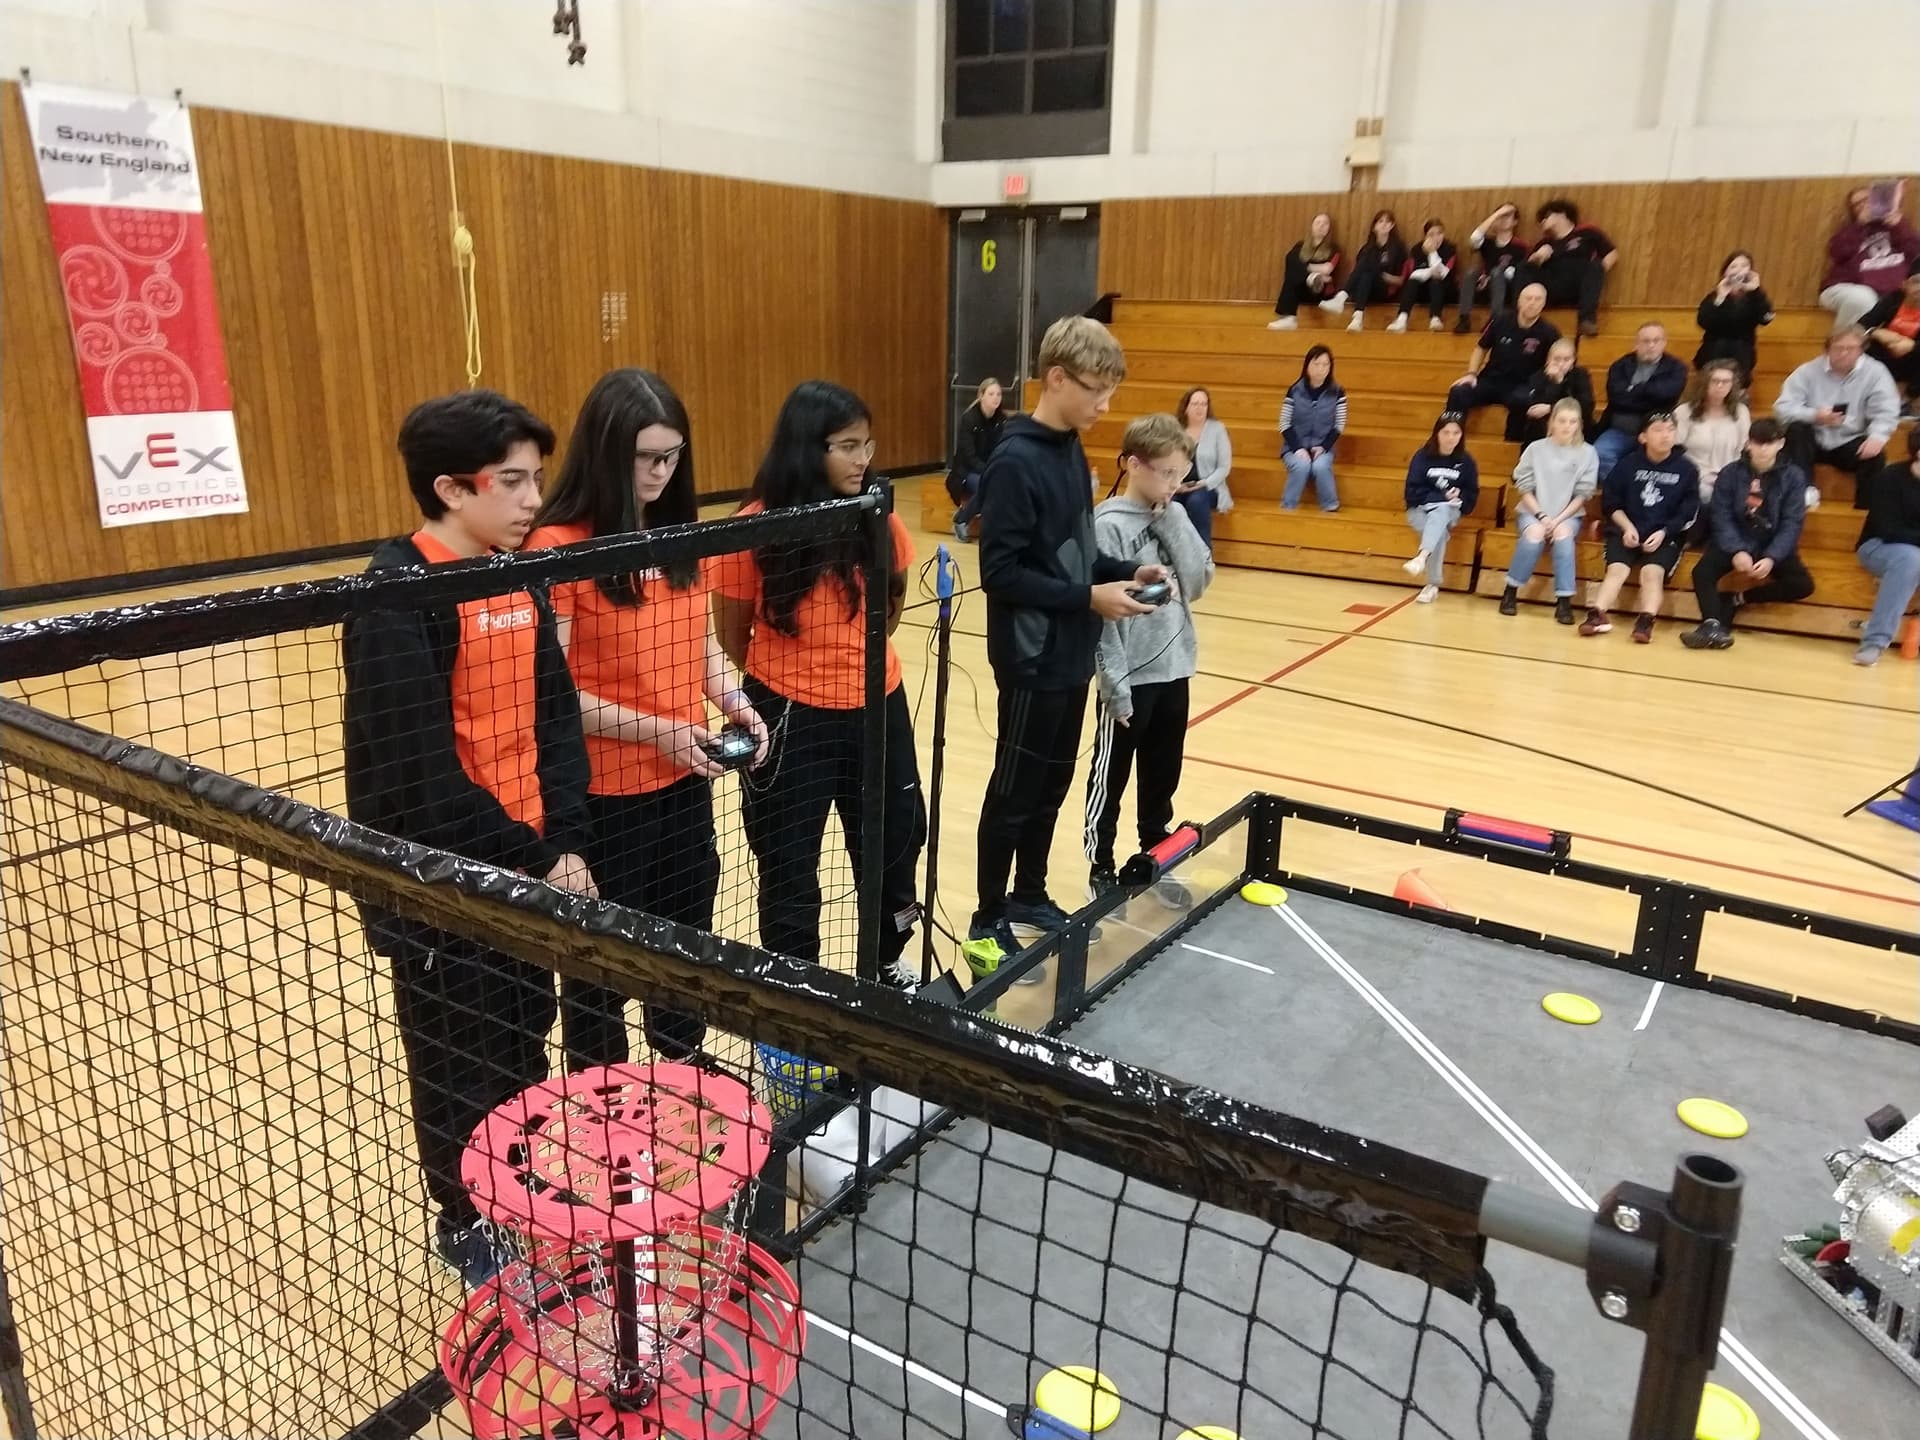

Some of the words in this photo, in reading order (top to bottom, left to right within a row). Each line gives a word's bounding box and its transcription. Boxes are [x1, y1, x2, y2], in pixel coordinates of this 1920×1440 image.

[56, 125, 169, 150] Southern
[39, 145, 94, 165] New
[100, 152, 191, 174] England
[981, 239, 997, 274] 6
[99, 432, 233, 480] VEX
[103, 476, 238, 498] ROBOTICS
[106, 493, 241, 516] COMPETITION
